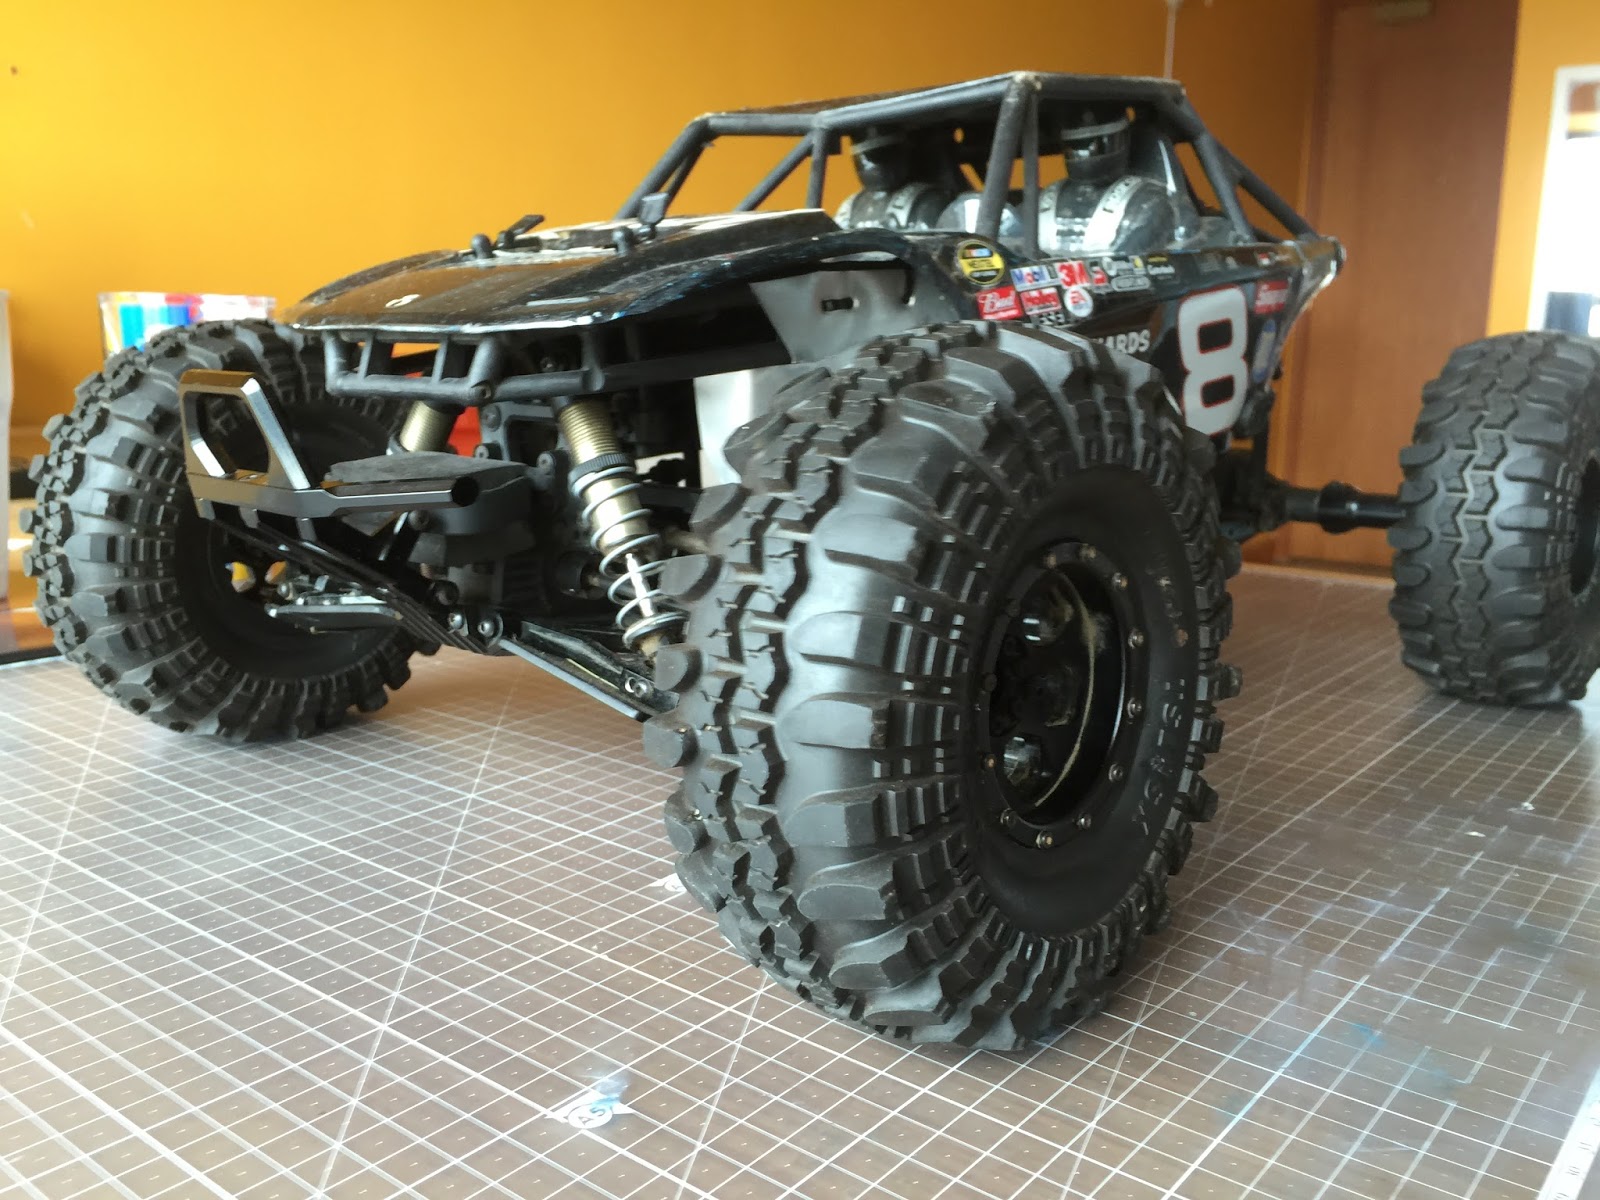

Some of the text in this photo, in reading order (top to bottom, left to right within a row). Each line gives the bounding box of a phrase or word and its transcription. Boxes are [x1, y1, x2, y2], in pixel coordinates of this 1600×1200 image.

[1057, 261, 1090, 287] 3M
[1093, 329, 1151, 354] ARDS
[1177, 285, 1248, 436] 8
